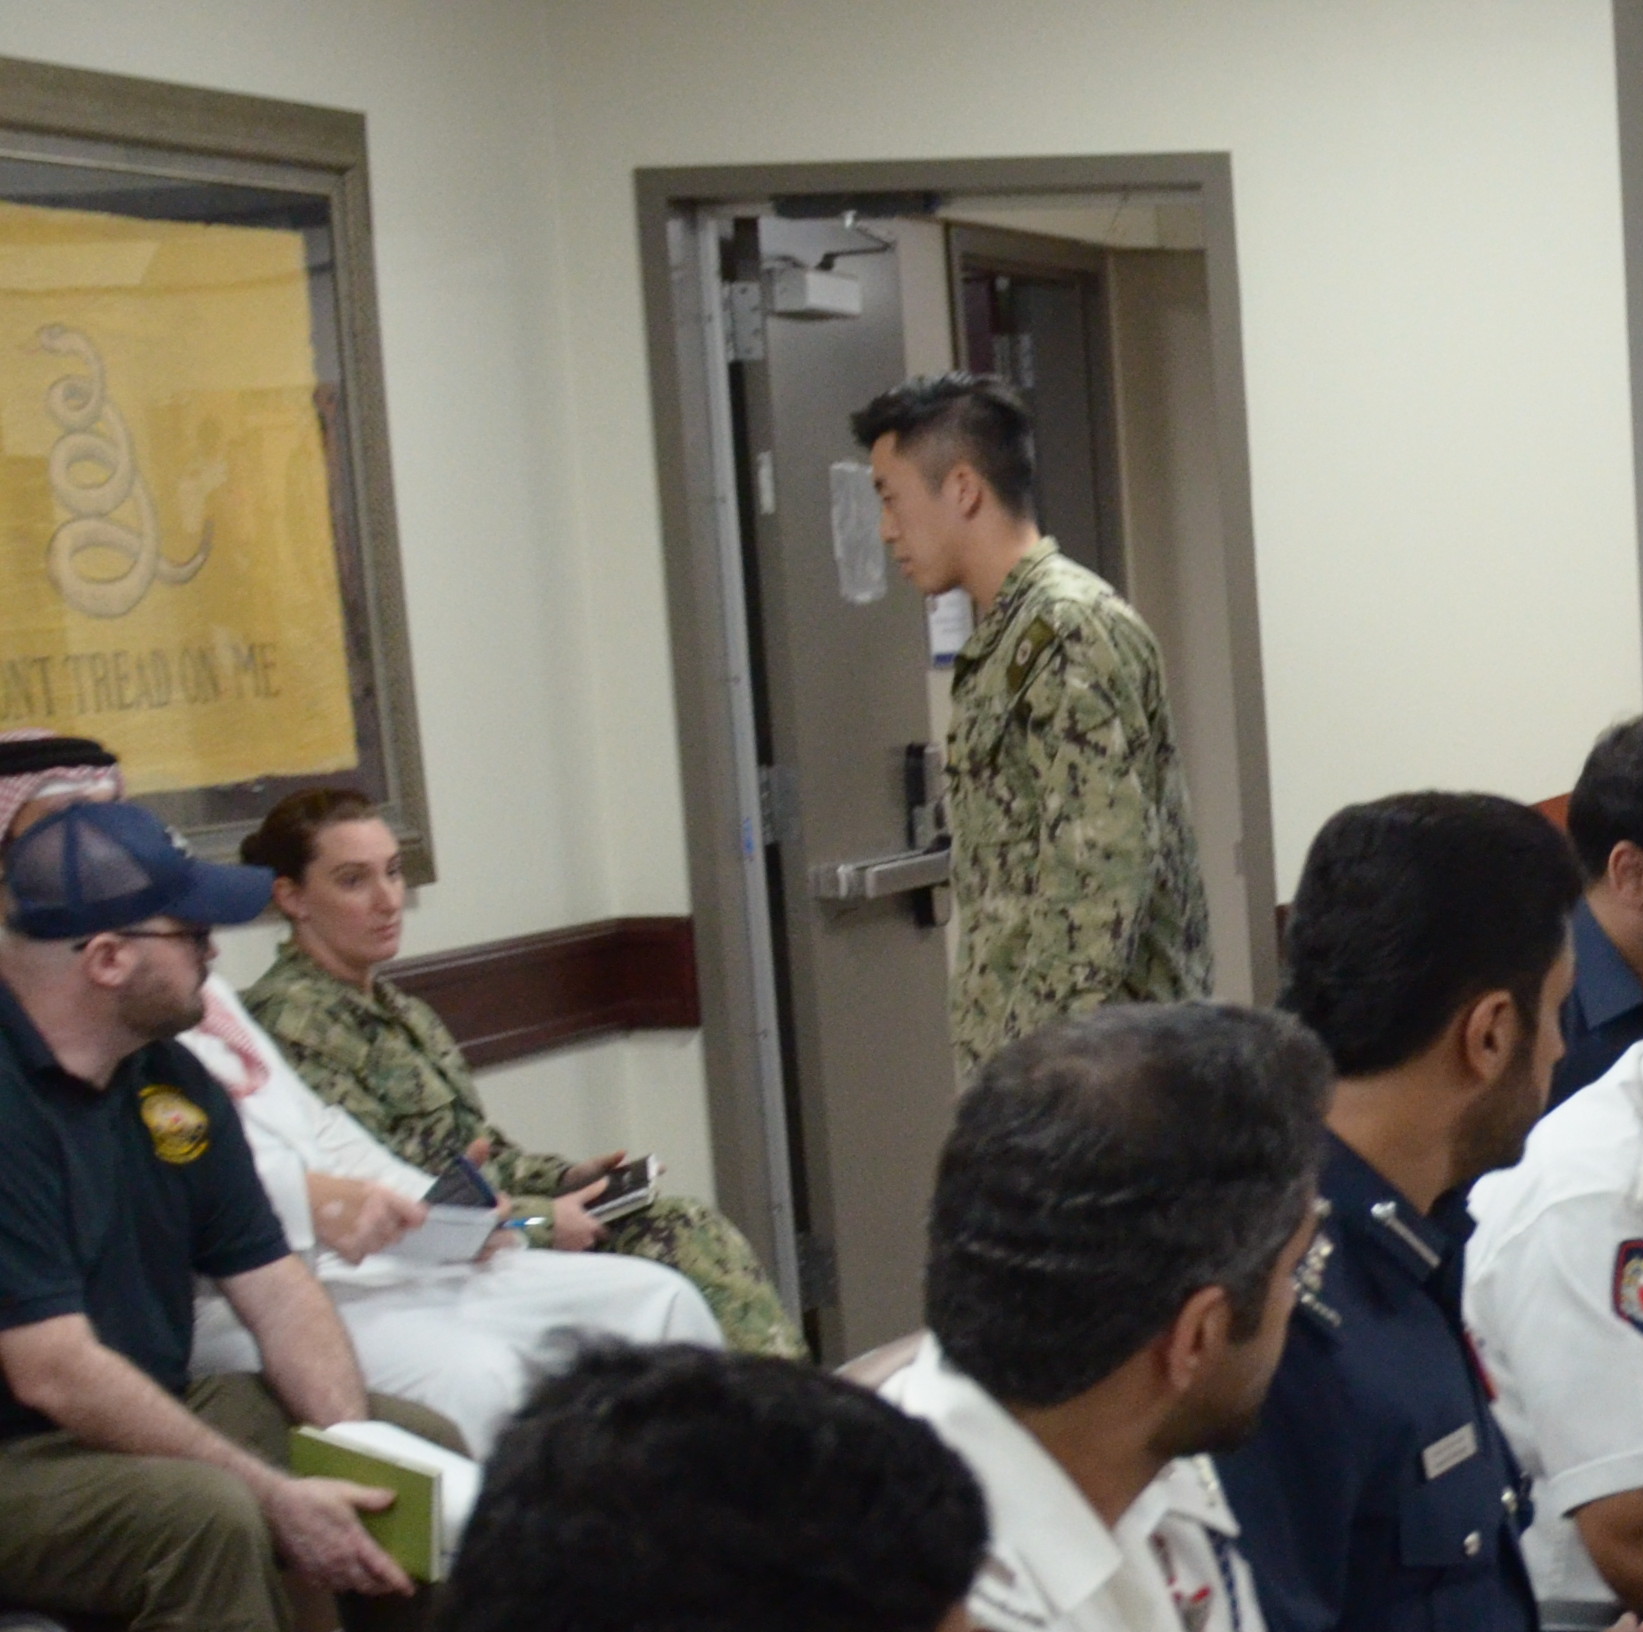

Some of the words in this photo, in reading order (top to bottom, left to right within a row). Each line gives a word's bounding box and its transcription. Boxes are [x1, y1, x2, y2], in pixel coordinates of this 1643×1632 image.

[63, 649, 172, 713] TREAD
[178, 645, 222, 705] ON
[230, 641, 281, 700] ME
